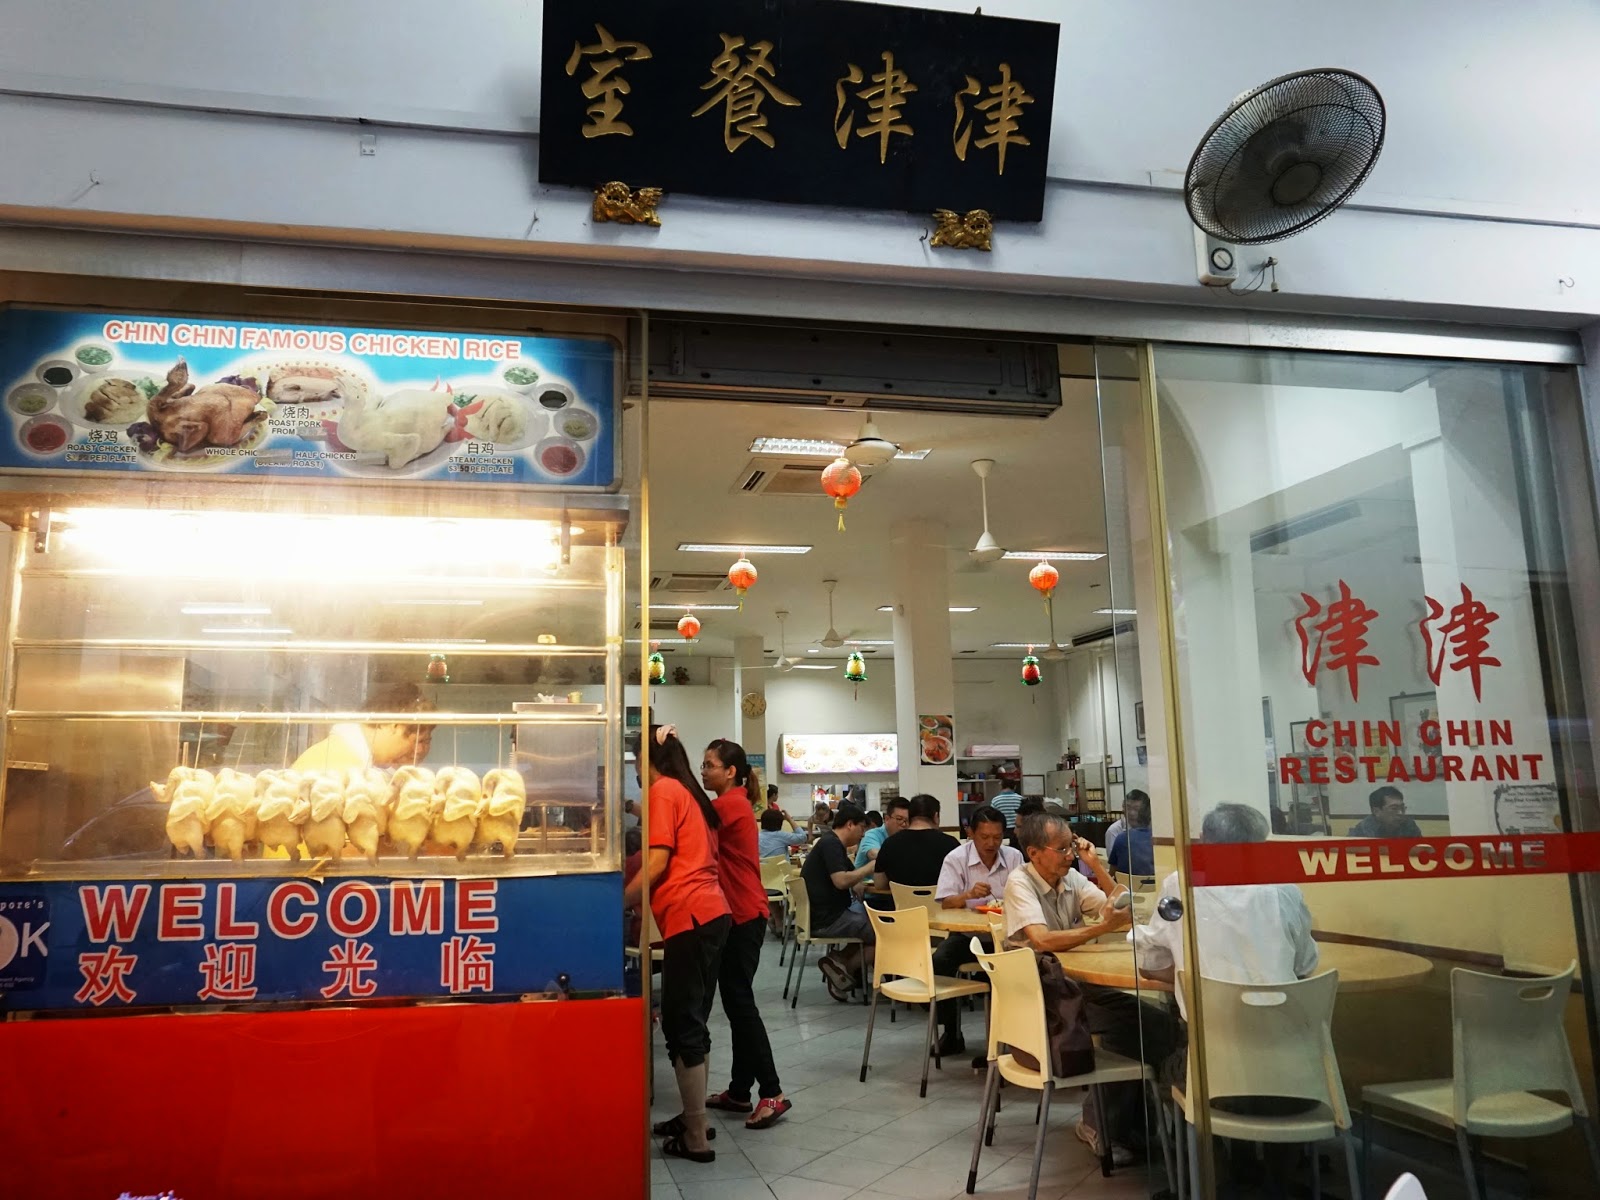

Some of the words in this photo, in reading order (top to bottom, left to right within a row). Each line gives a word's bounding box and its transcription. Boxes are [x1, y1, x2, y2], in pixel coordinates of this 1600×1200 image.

[104, 320, 168, 344] CHIN
[172, 324, 236, 348] CHIN
[241, 328, 345, 352] FAMOUS
[350, 333, 459, 358] CHICKEN
[464, 339, 520, 360] RICE
[282, 405, 310, 420] 烧肉
[268, 419, 296, 427] ROAST
[298, 420, 322, 428] PORK
[271, 427, 296, 435] FROM
[88, 428, 119, 444] 烧鸡
[66, 444, 96, 452] ROAST
[98, 445, 138, 453] CHICKEN
[205, 448, 237, 456] WHOLE
[238, 449, 258, 457] CHIC
[294, 450, 318, 459] HALF
[319, 452, 357, 460] CHICKEN
[467, 441, 495, 456] 白鸡
[90, 454, 109, 462] PER
[109, 455, 137, 463] PLATE
[448, 456, 476, 464] STEAM
[478, 457, 513, 465] CHICKEN
[470, 465, 486, 473] PER
[488, 466, 513, 474] PLATE
[1295, 578, 1502, 703] 津津
[1304, 719, 1402, 748] CHIN
[1419, 719, 1513, 747] CHIN
[1279, 753, 1544, 785] RESTAURANT
[1297, 840, 1548, 876] WELCOME
[79, 879, 499, 943] WELCOME
[74, 935, 496, 1005] 欢迎光临
